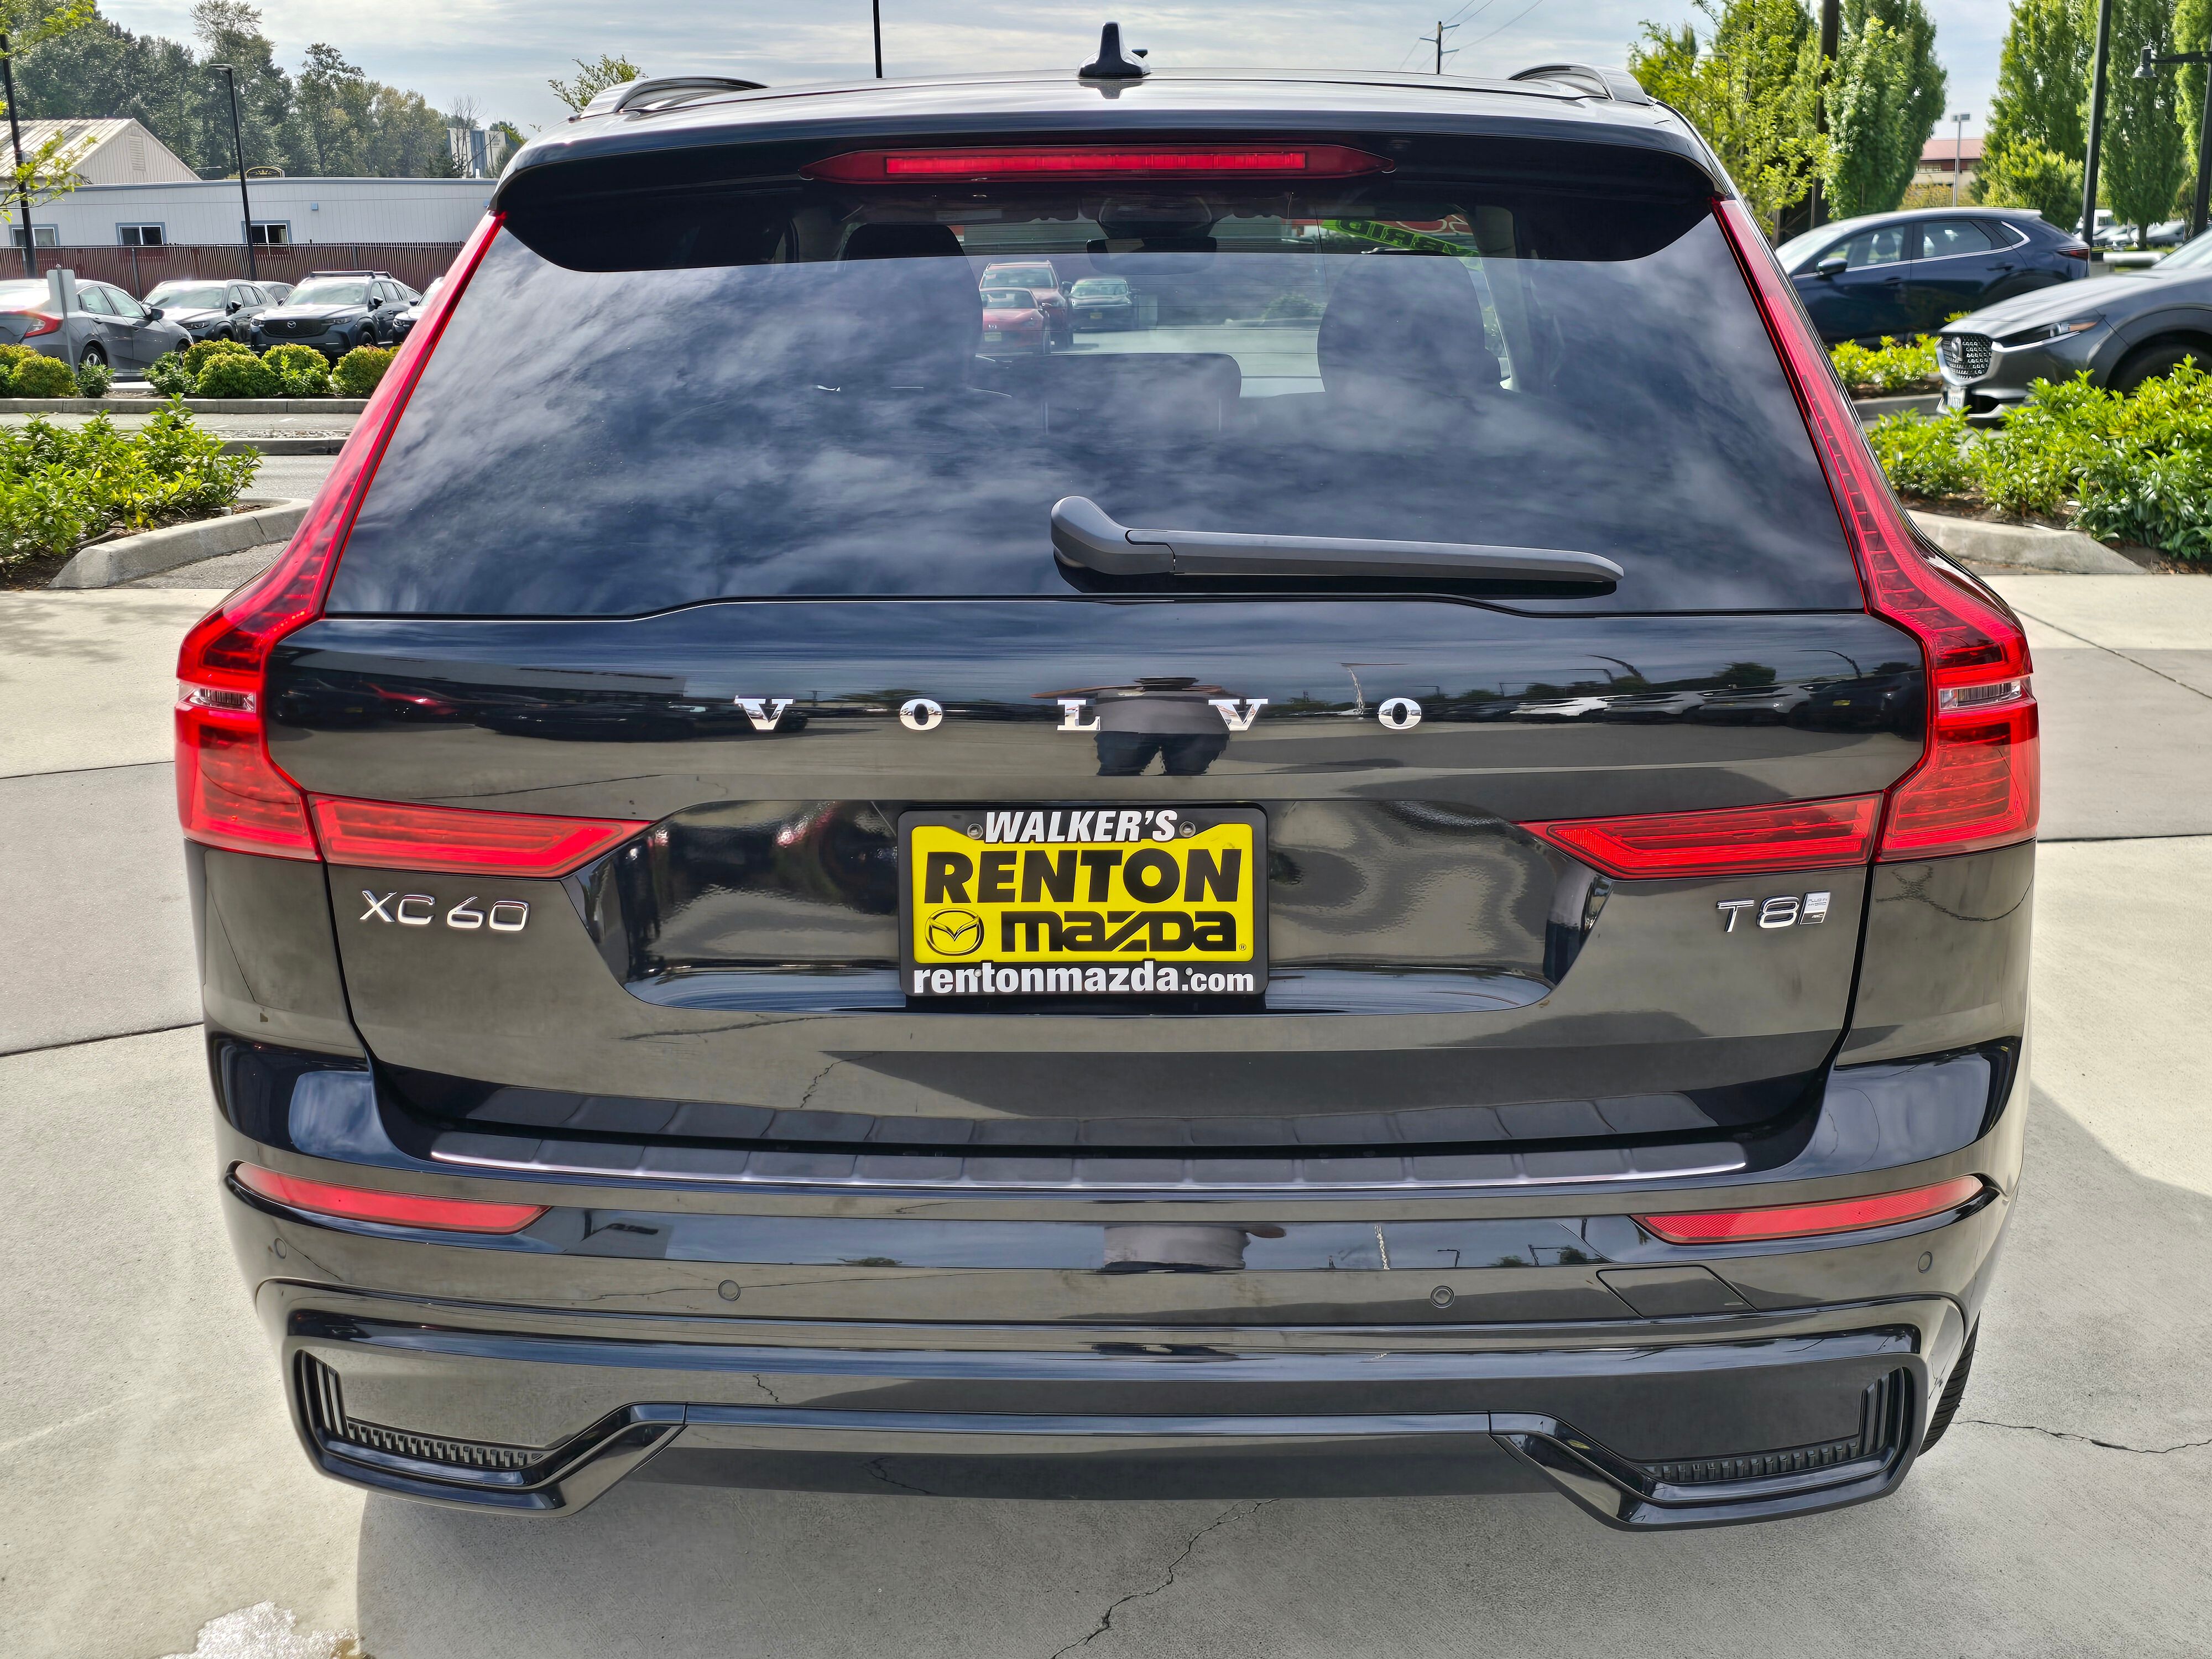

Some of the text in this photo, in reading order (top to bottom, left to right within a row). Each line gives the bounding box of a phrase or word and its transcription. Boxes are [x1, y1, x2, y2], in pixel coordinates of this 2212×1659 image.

[734, 697, 1423, 731] VOLVO
[984, 810, 1178, 843] WALKER'S
[924, 848, 1242, 904] RENTON
[1717, 895, 1799, 933] T8
[913, 960, 1254, 994] rentonmazda.com
